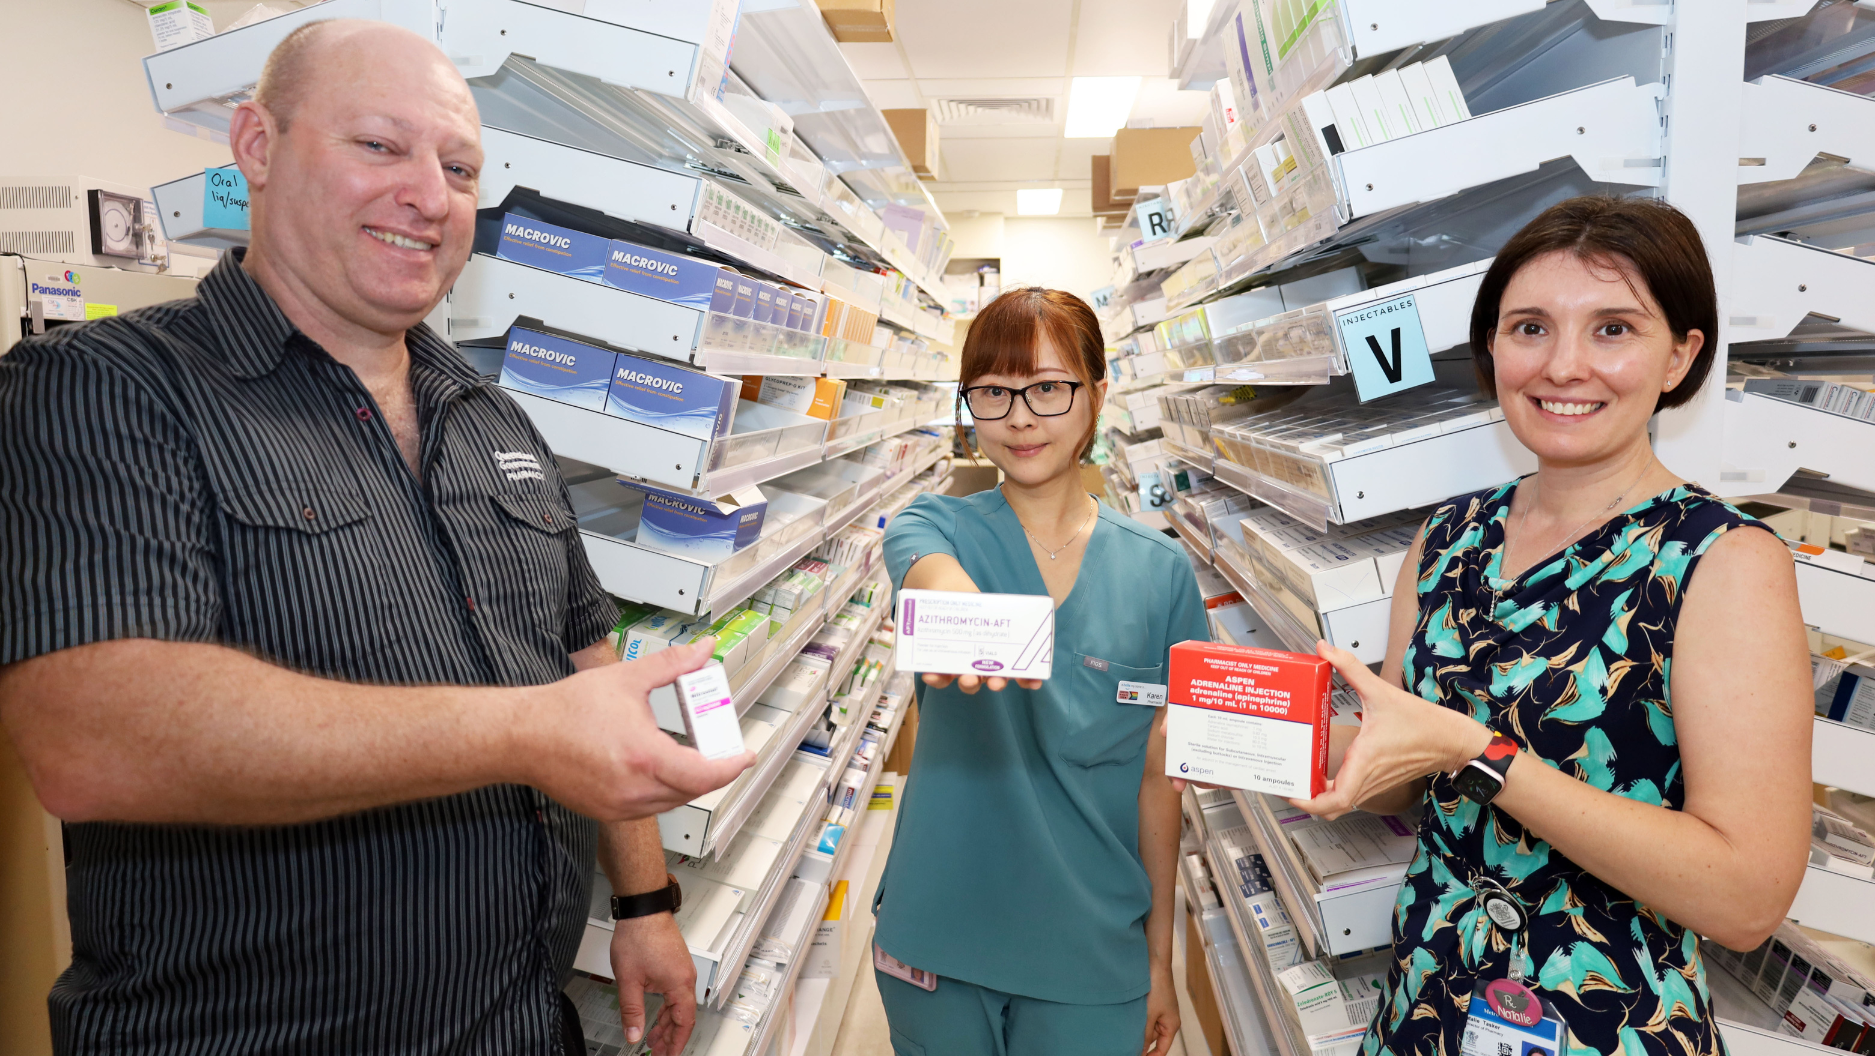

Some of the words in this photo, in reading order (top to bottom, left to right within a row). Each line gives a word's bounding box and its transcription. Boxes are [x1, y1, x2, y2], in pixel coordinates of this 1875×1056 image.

[211, 172, 238, 189] Oral
[505, 223, 571, 249] MACROVIC
[503, 236, 522, 245] Effective
[522, 240, 534, 248] relief
[546, 246, 572, 257] constipation
[612, 250, 678, 276] MACROVIC
[610, 262, 629, 271] Effective
[629, 267, 641, 275] relief
[652, 273, 680, 285] constipation
[31, 283, 81, 298] Panasonic
[1342, 300, 1413, 326] INJECTABLES
[508, 352, 528, 362] Effective
[527, 357, 540, 365] relief
[551, 364, 578, 375] constipation
[510, 341, 576, 367] MACROVIC
[1365, 327, 1402, 384] V
[617, 367, 683, 394] MACROVIC
[615, 380, 634, 389] Effective
[657, 390, 685, 402] constipation
[507, 470, 546, 481] PHARMACY
[917, 627, 951, 636] Azithromycin
[918, 615, 1011, 628] AZITHROMYCIN-AFT
[1090, 660, 1102, 668] FIGS
[1204, 658, 1237, 668] PHARMACIST
[1253, 663, 1279, 673] MEDICINE
[1190, 679, 1244, 693] ADRENALINE
[1245, 686, 1291, 699] INJECTION
[1225, 675, 1255, 686] ASPEN
[1147, 692, 1163, 700] Karen
[1190, 687, 1233, 699] adrenaline
[1234, 692, 1291, 708] (epinephrine)
[1199, 696, 1223, 706] mg/10
[1225, 700, 1238, 708] mL
[1239, 701, 1247, 709] (1
[1249, 703, 1257, 711] in
[1259, 704, 1288, 716] 10000)
[1201, 743, 1218, 751] solution
[1190, 766, 1214, 776] aspen
[1262, 777, 1295, 787] ampoules
[1483, 1020, 1501, 1030] Tasker
[1497, 1005, 1533, 1025] Natalie
